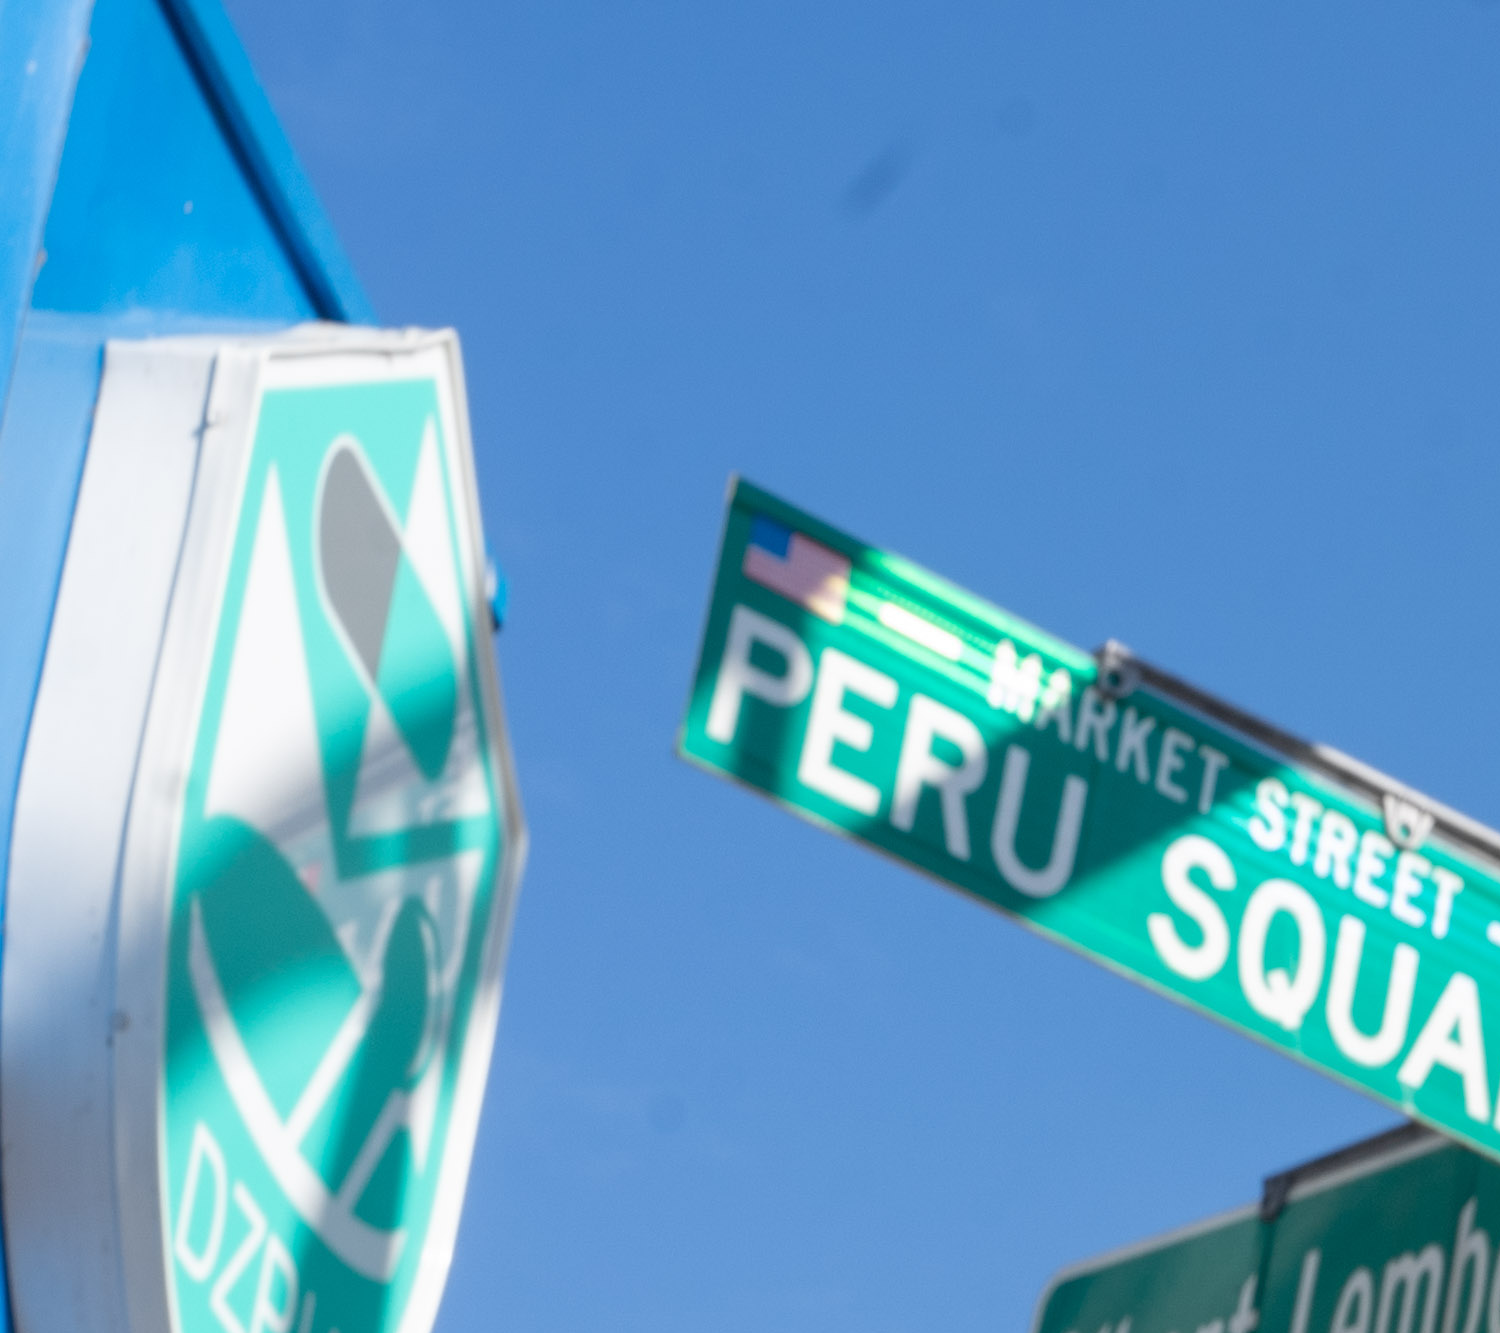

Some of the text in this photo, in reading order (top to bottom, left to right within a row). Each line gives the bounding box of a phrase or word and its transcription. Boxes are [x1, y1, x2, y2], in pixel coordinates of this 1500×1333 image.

[705, 606, 1087, 898] PERU
[987, 638, 1463, 937] MARKET STREET
